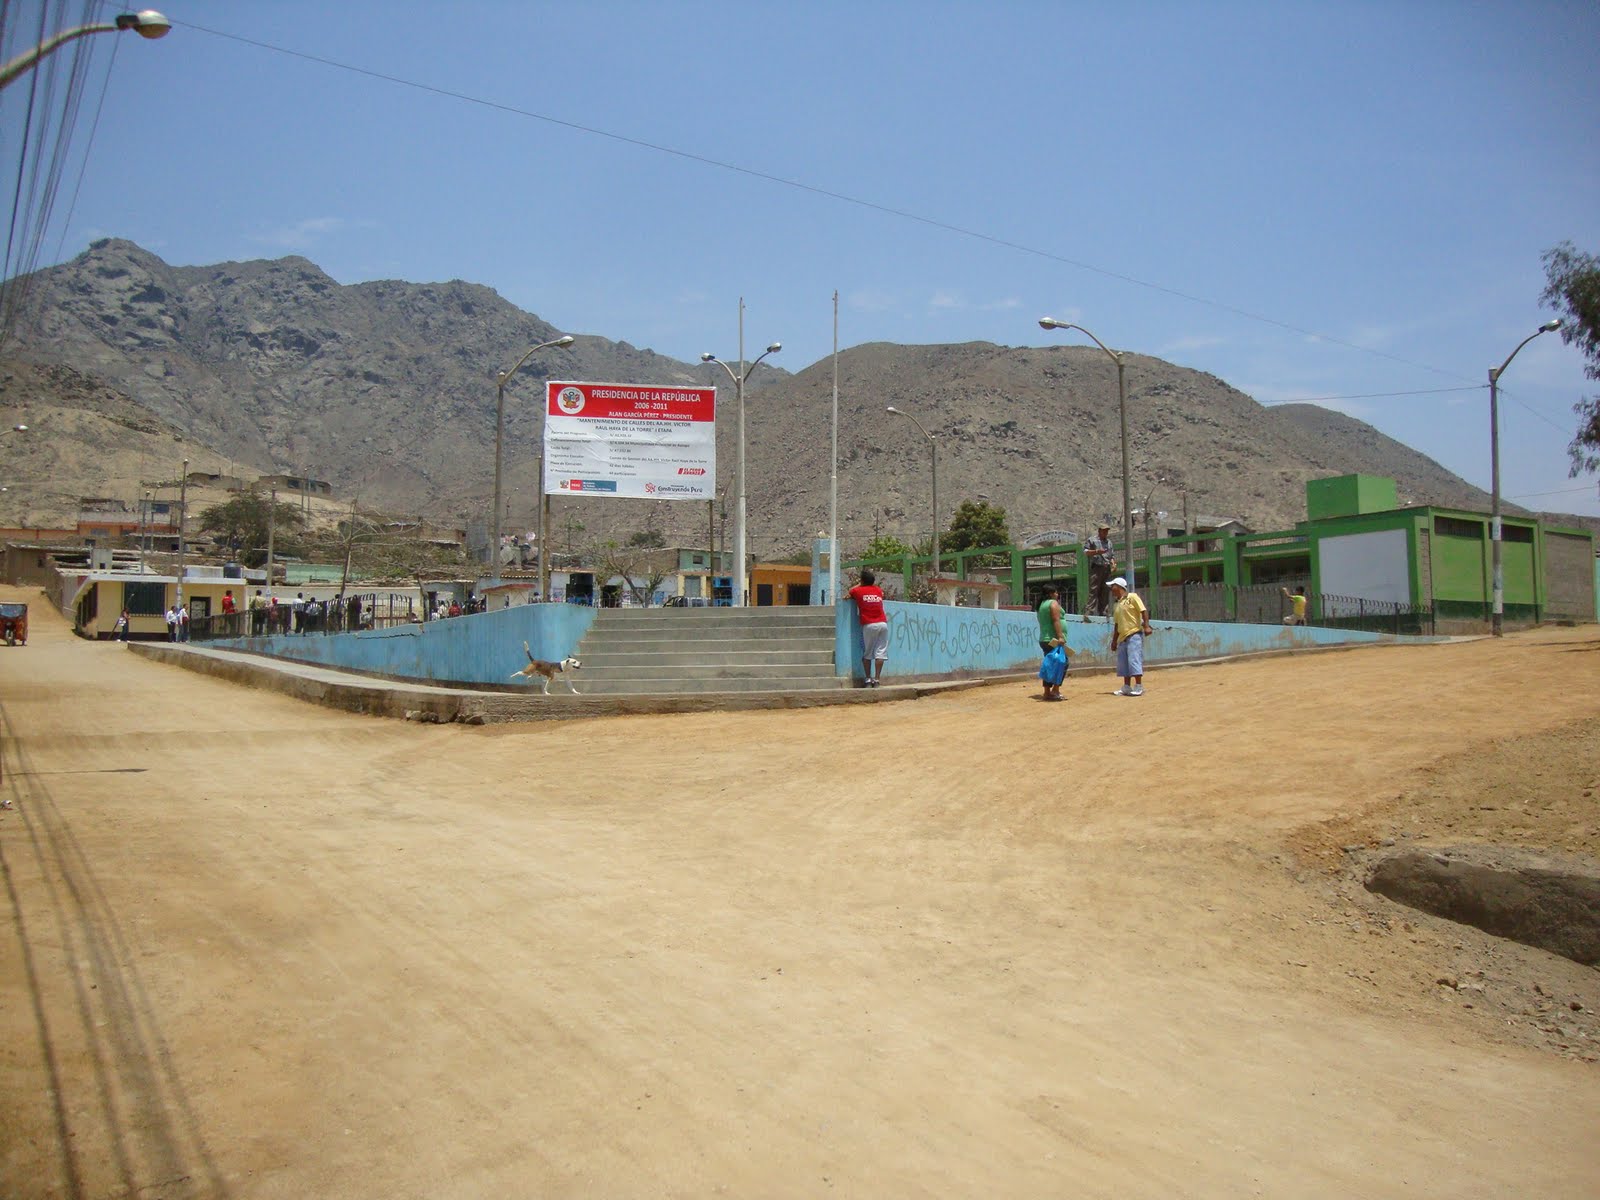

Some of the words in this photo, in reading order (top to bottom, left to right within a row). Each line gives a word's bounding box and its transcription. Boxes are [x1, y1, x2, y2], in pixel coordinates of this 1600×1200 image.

[592, 390, 639, 400] PRESIDENCIA
[640, 392, 650, 400] DE
[651, 392, 660, 400] LA
[662, 391, 700, 402] REPÚBLICA
